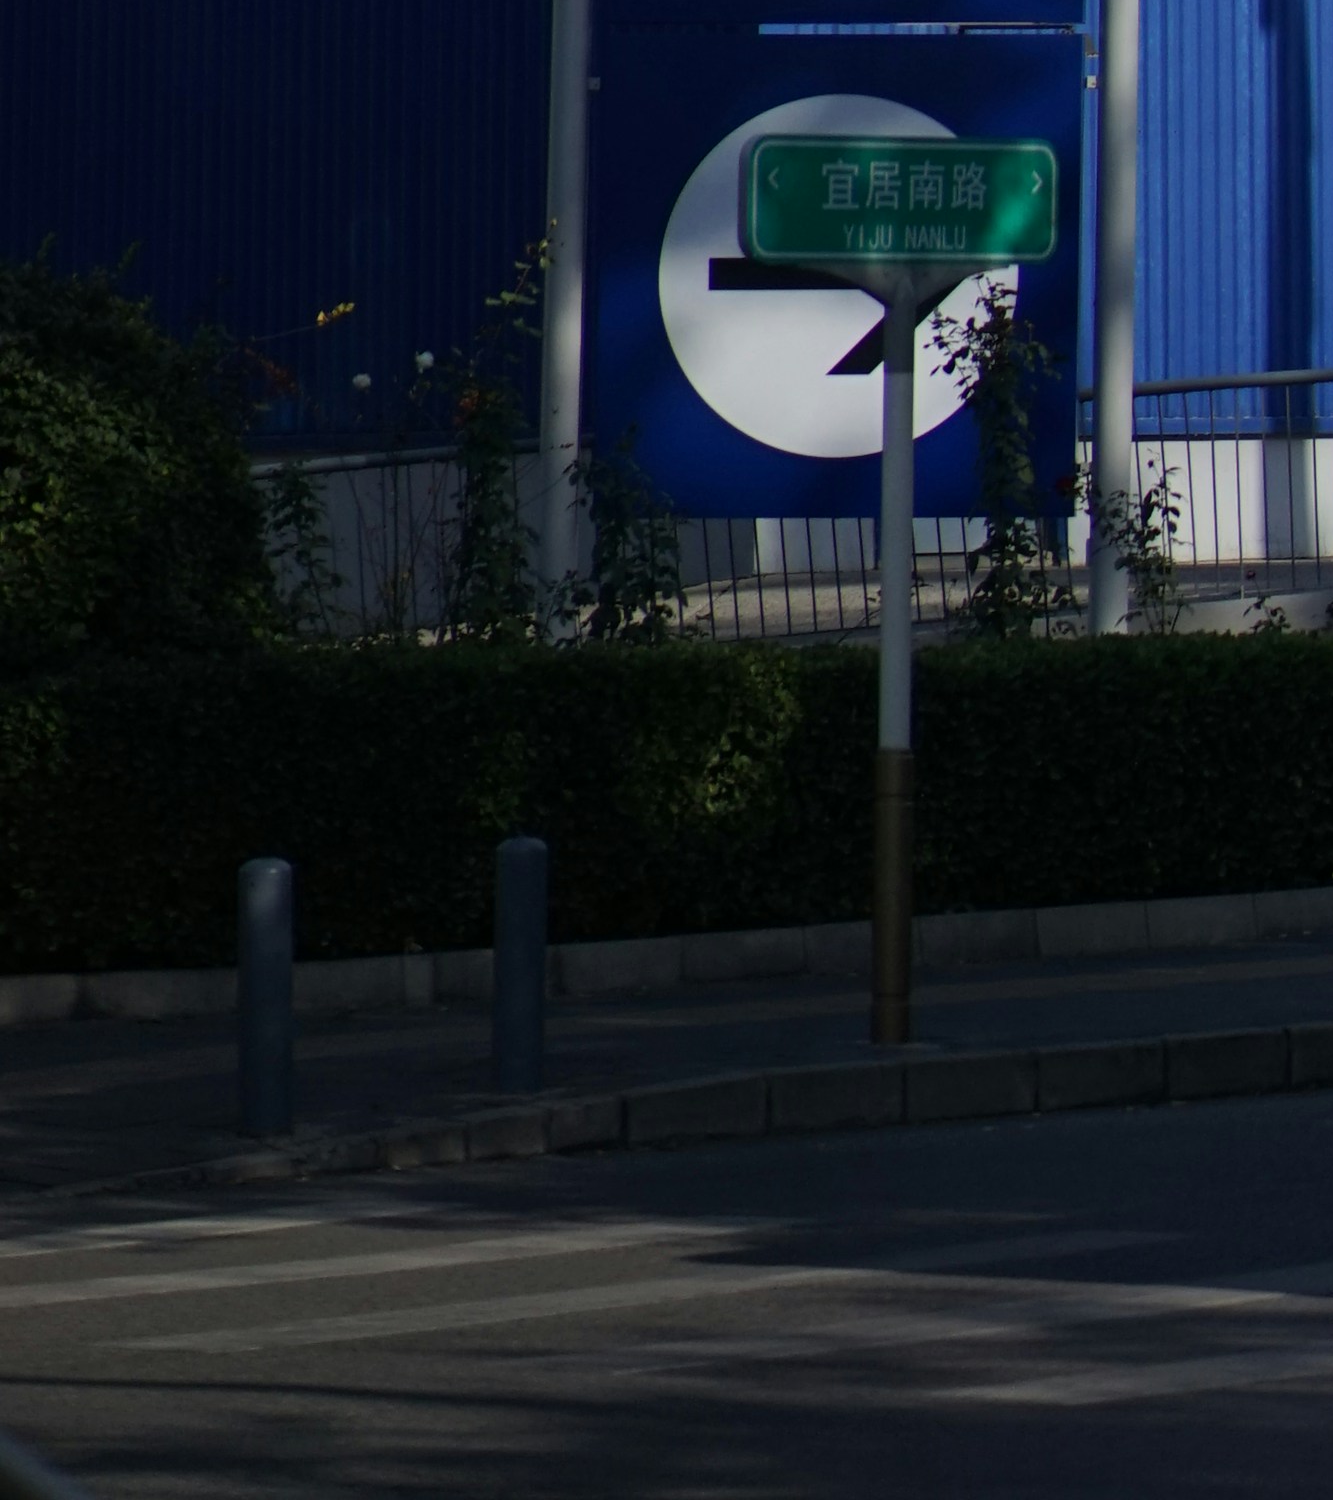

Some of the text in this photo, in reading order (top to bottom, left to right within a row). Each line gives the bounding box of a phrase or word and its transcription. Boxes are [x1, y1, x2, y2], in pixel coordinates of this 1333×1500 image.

[822, 160, 987, 211] 宜居南路
[843, 224, 967, 250] YIJU NANLU
